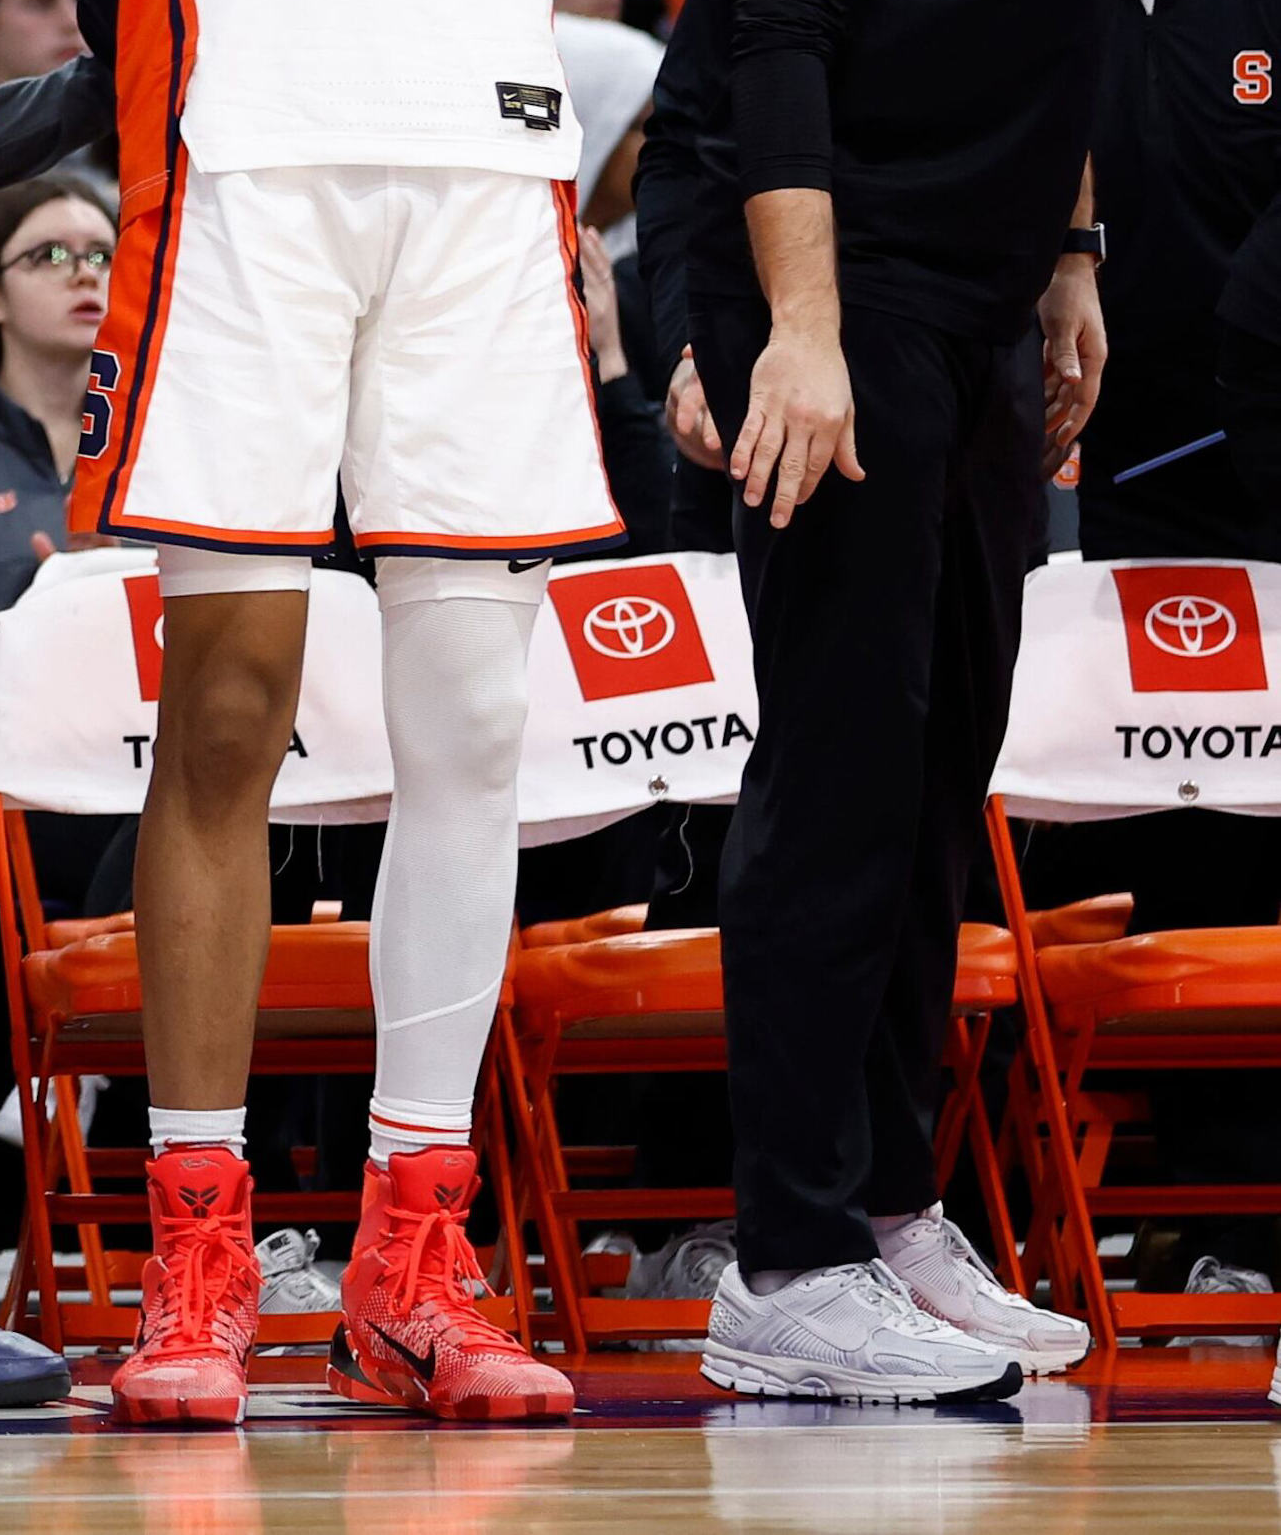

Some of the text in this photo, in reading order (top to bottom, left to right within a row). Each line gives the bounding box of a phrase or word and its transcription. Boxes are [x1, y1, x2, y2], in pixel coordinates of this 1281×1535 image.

[1232, 49, 1272, 105] S
[573, 712, 756, 770] TOYOTA
[1115, 725, 1281, 759] TOYOTA
